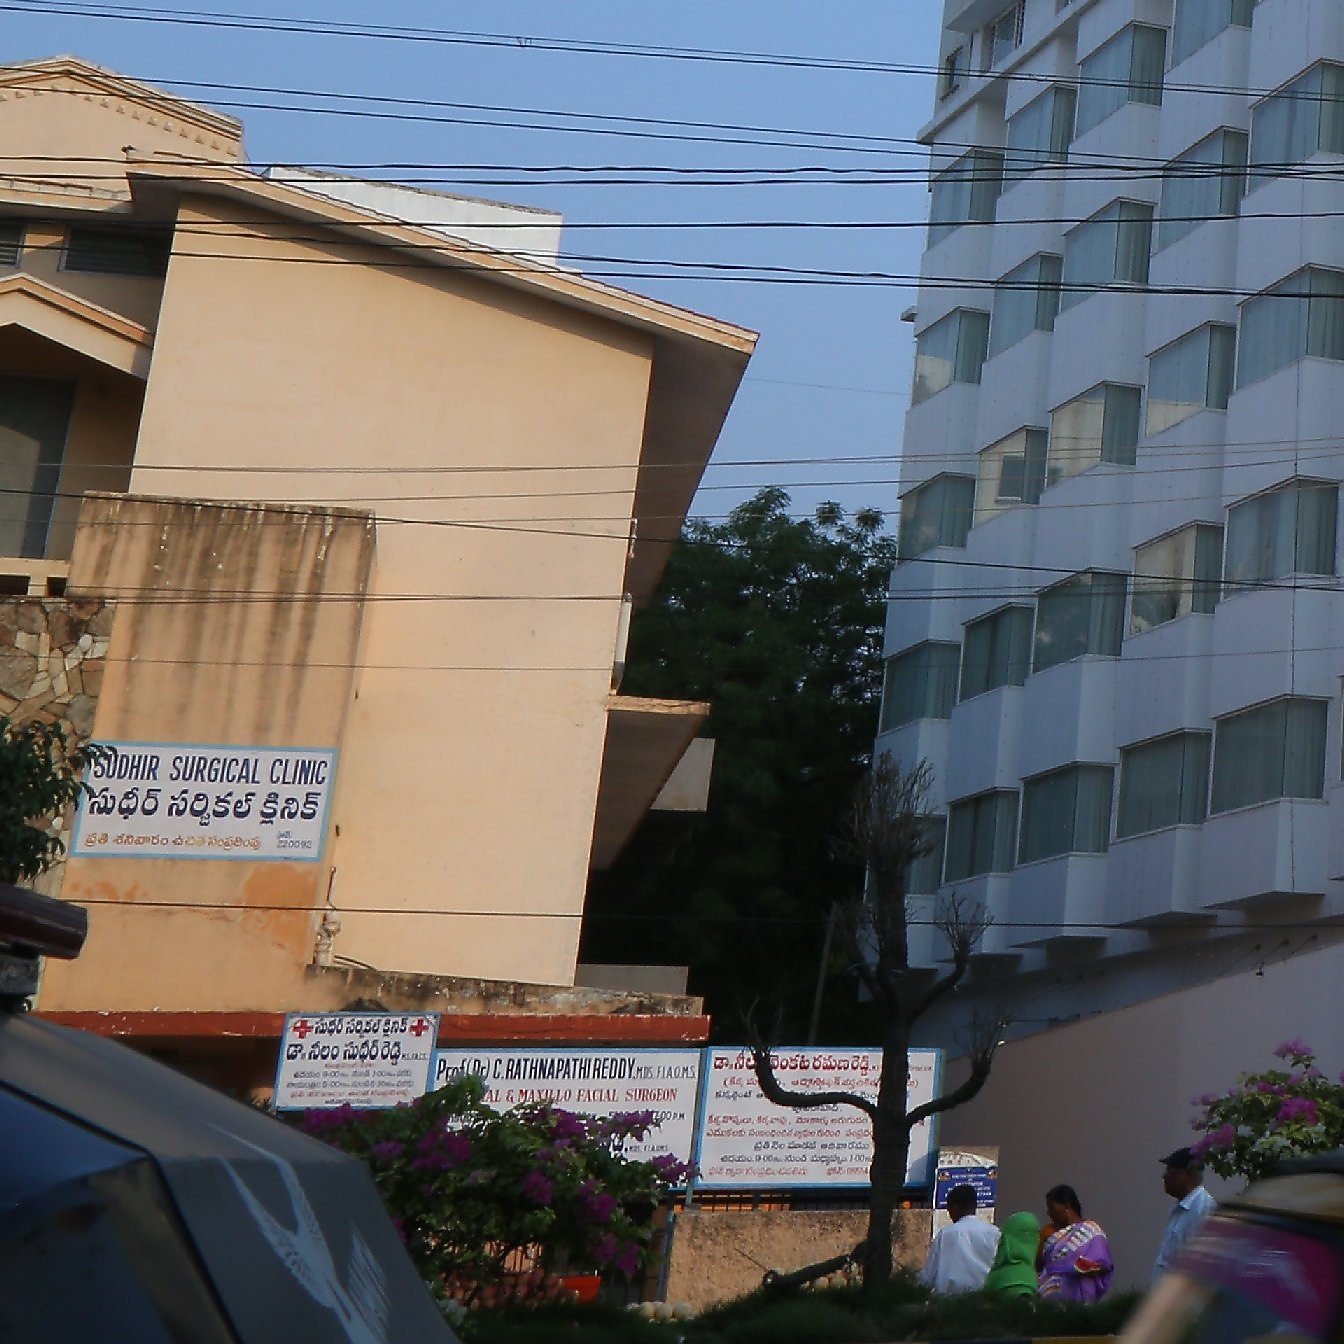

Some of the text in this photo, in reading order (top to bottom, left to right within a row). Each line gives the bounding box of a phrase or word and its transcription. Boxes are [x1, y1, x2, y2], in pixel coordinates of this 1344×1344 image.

[169, 755, 261, 785] SURGICAL
[270, 758, 328, 786] CLINIC
[259, 791, 322, 825] క్లినిక్
[505, 1088, 515, 1103] &
[517, 1088, 572, 1103] MAXILLO
[576, 1088, 620, 1103] FACIAL
[624, 1088, 678, 1102] SURGEON
